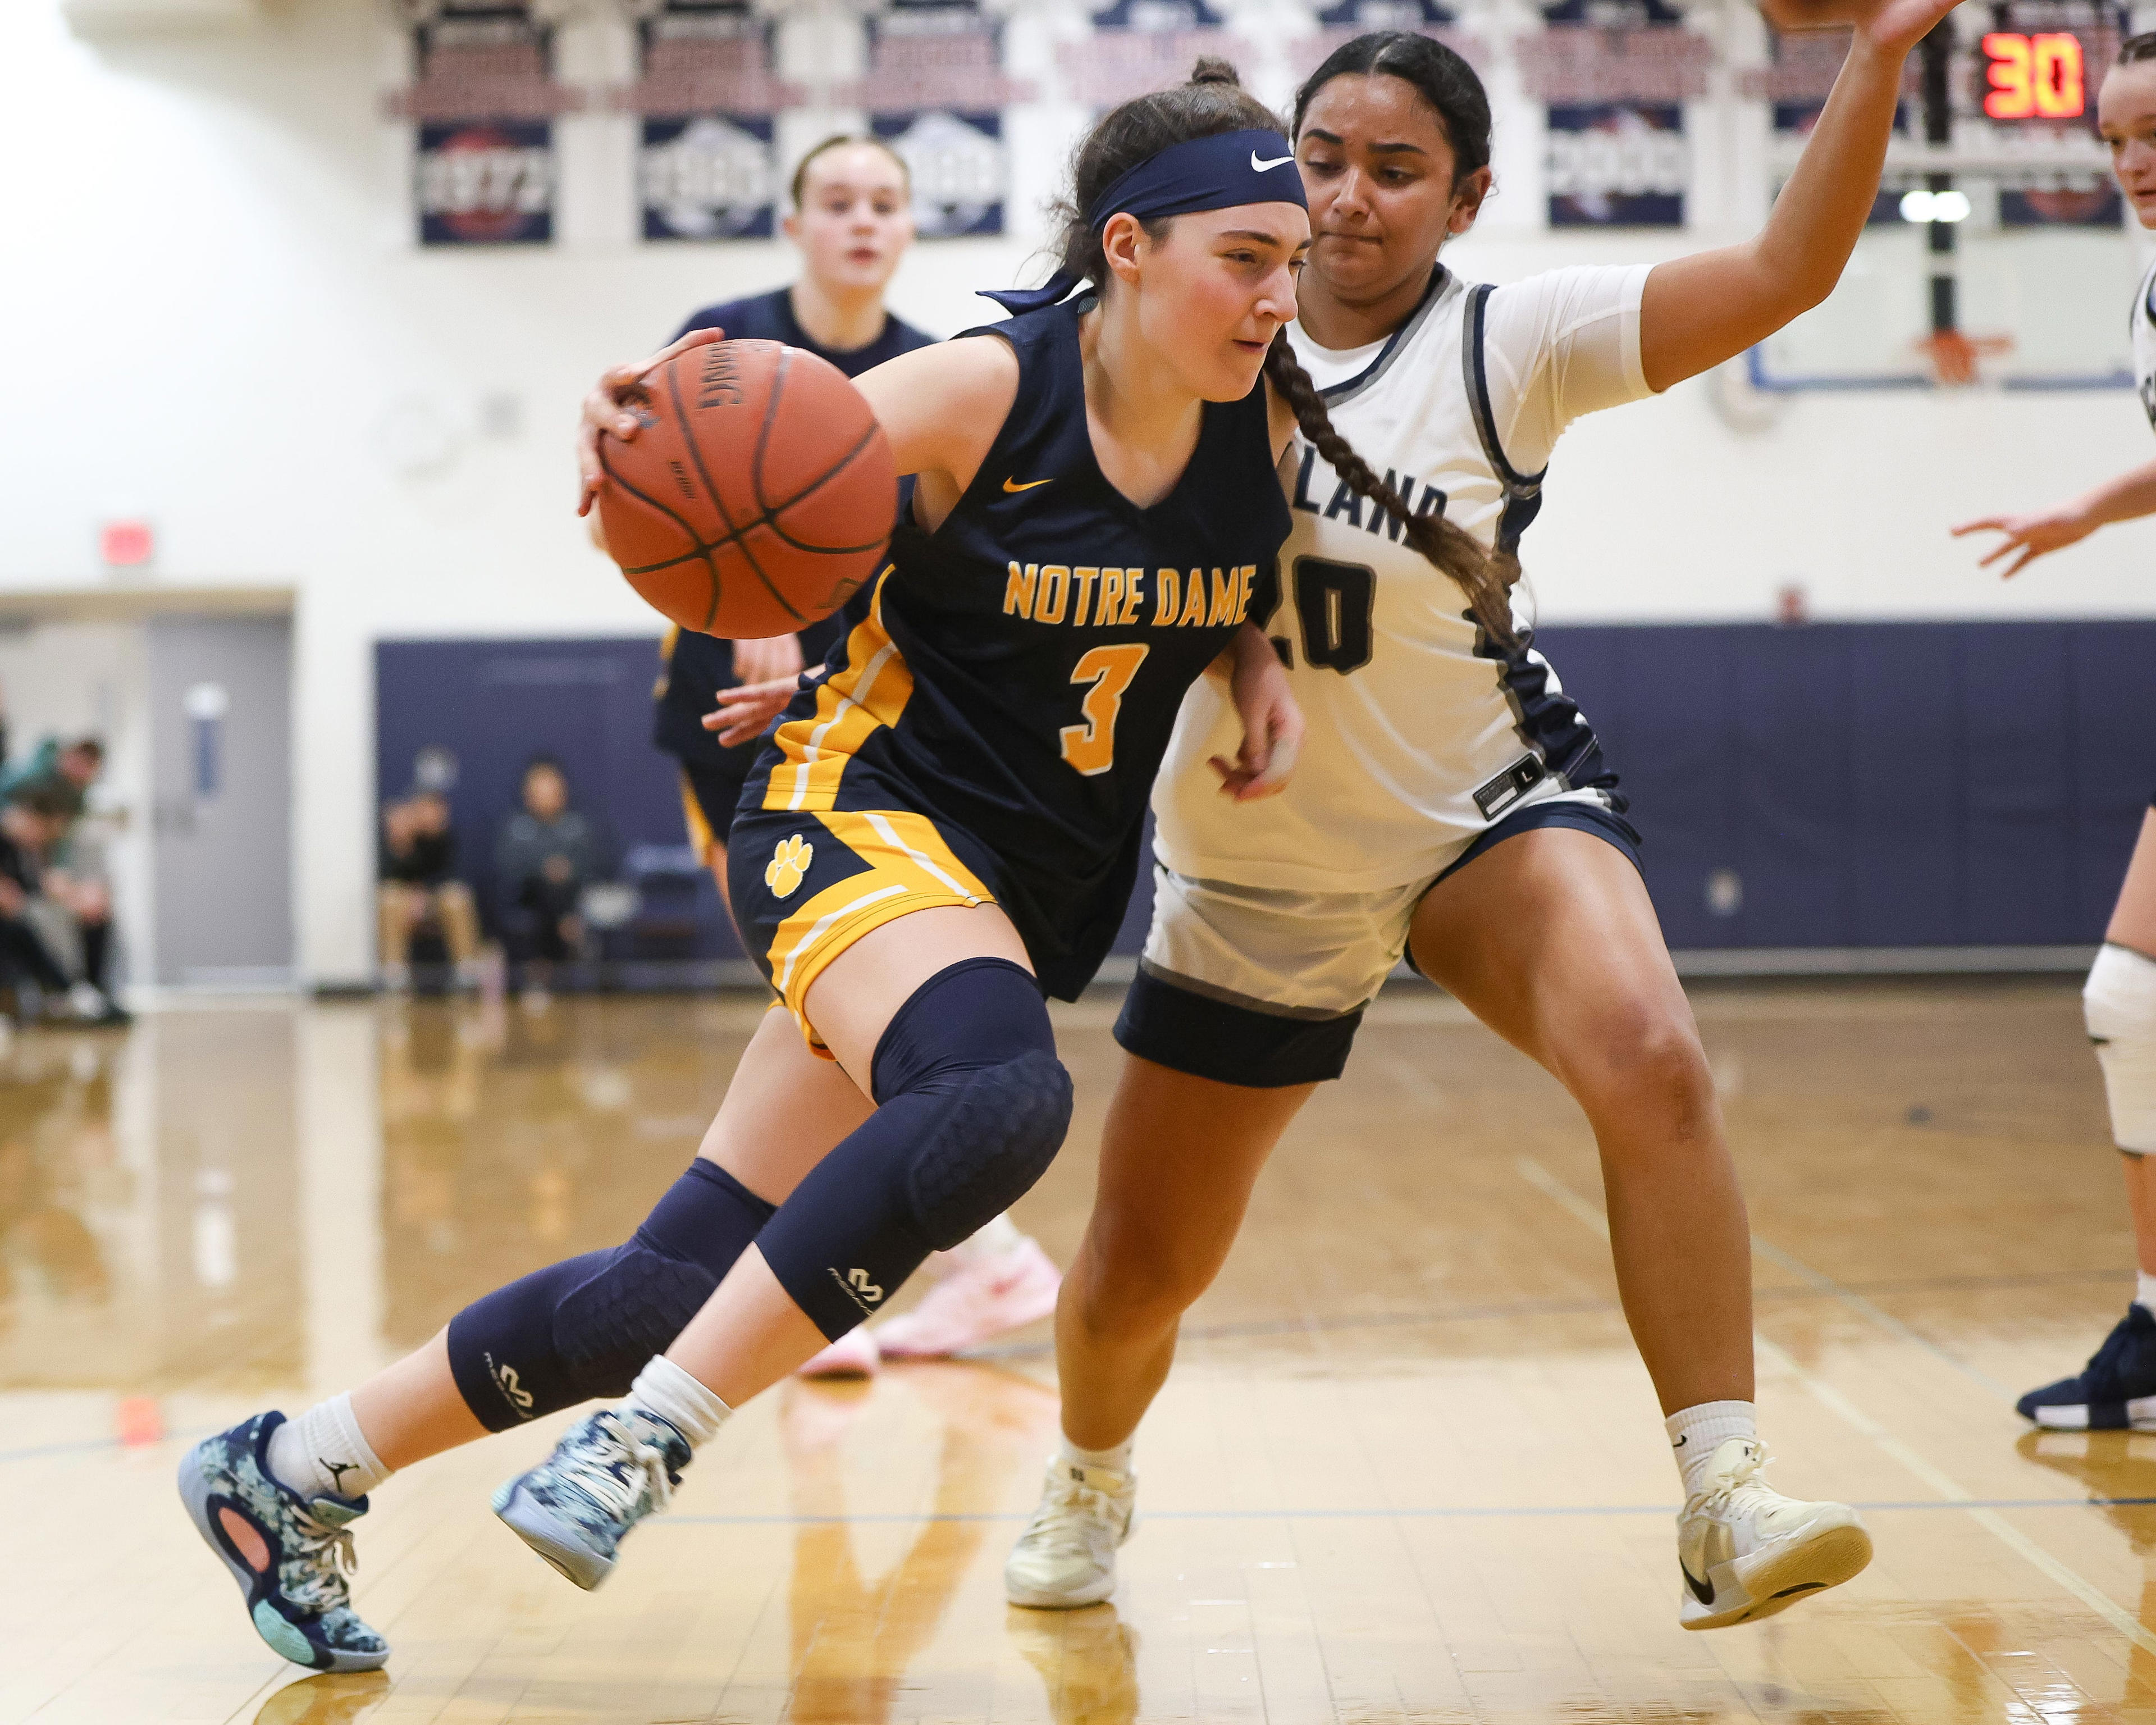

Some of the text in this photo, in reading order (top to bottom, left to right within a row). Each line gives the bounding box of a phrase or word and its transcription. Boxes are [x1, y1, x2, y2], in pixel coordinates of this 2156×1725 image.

[1983, 33, 2084, 118] 30
[1003, 560, 1257, 627] NOTRE DAME
[1059, 642, 1150, 776] 3
[1522, 771, 1533, 783] L
